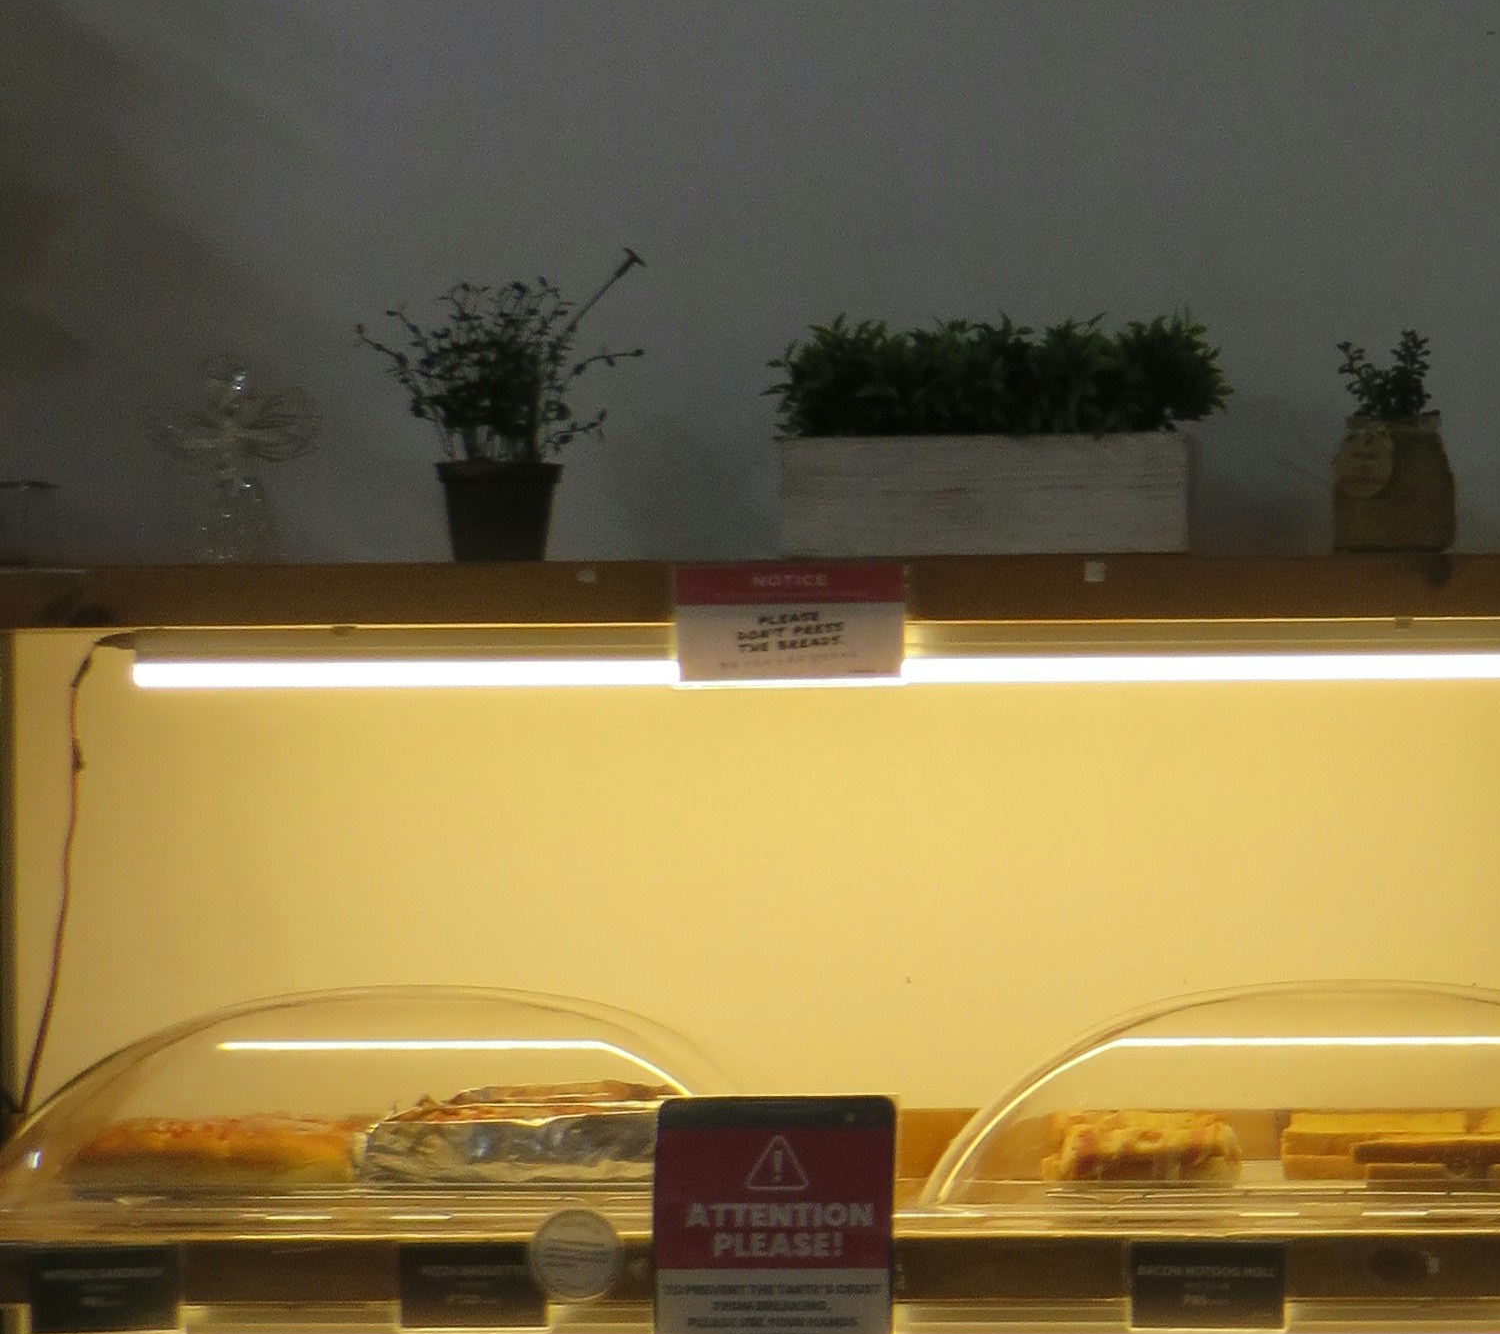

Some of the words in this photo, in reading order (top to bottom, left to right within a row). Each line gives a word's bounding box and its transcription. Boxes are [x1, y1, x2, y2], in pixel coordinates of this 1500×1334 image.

[752, 574, 828, 587] NOTICE
[758, 611, 820, 626] PLEASE
[737, 628, 784, 641] DON'T
[793, 622, 844, 636] PRESS
[738, 643, 769, 654] THE
[685, 1201, 876, 1228] ATTENTION
[712, 1231, 845, 1258] PLEASE!
[1137, 1265, 1182, 1276] BACON
[1185, 1265, 1241, 1277] HOTDOG
[750, 1284, 774, 1295] THE
[768, 1317, 806, 1327] YOUR
